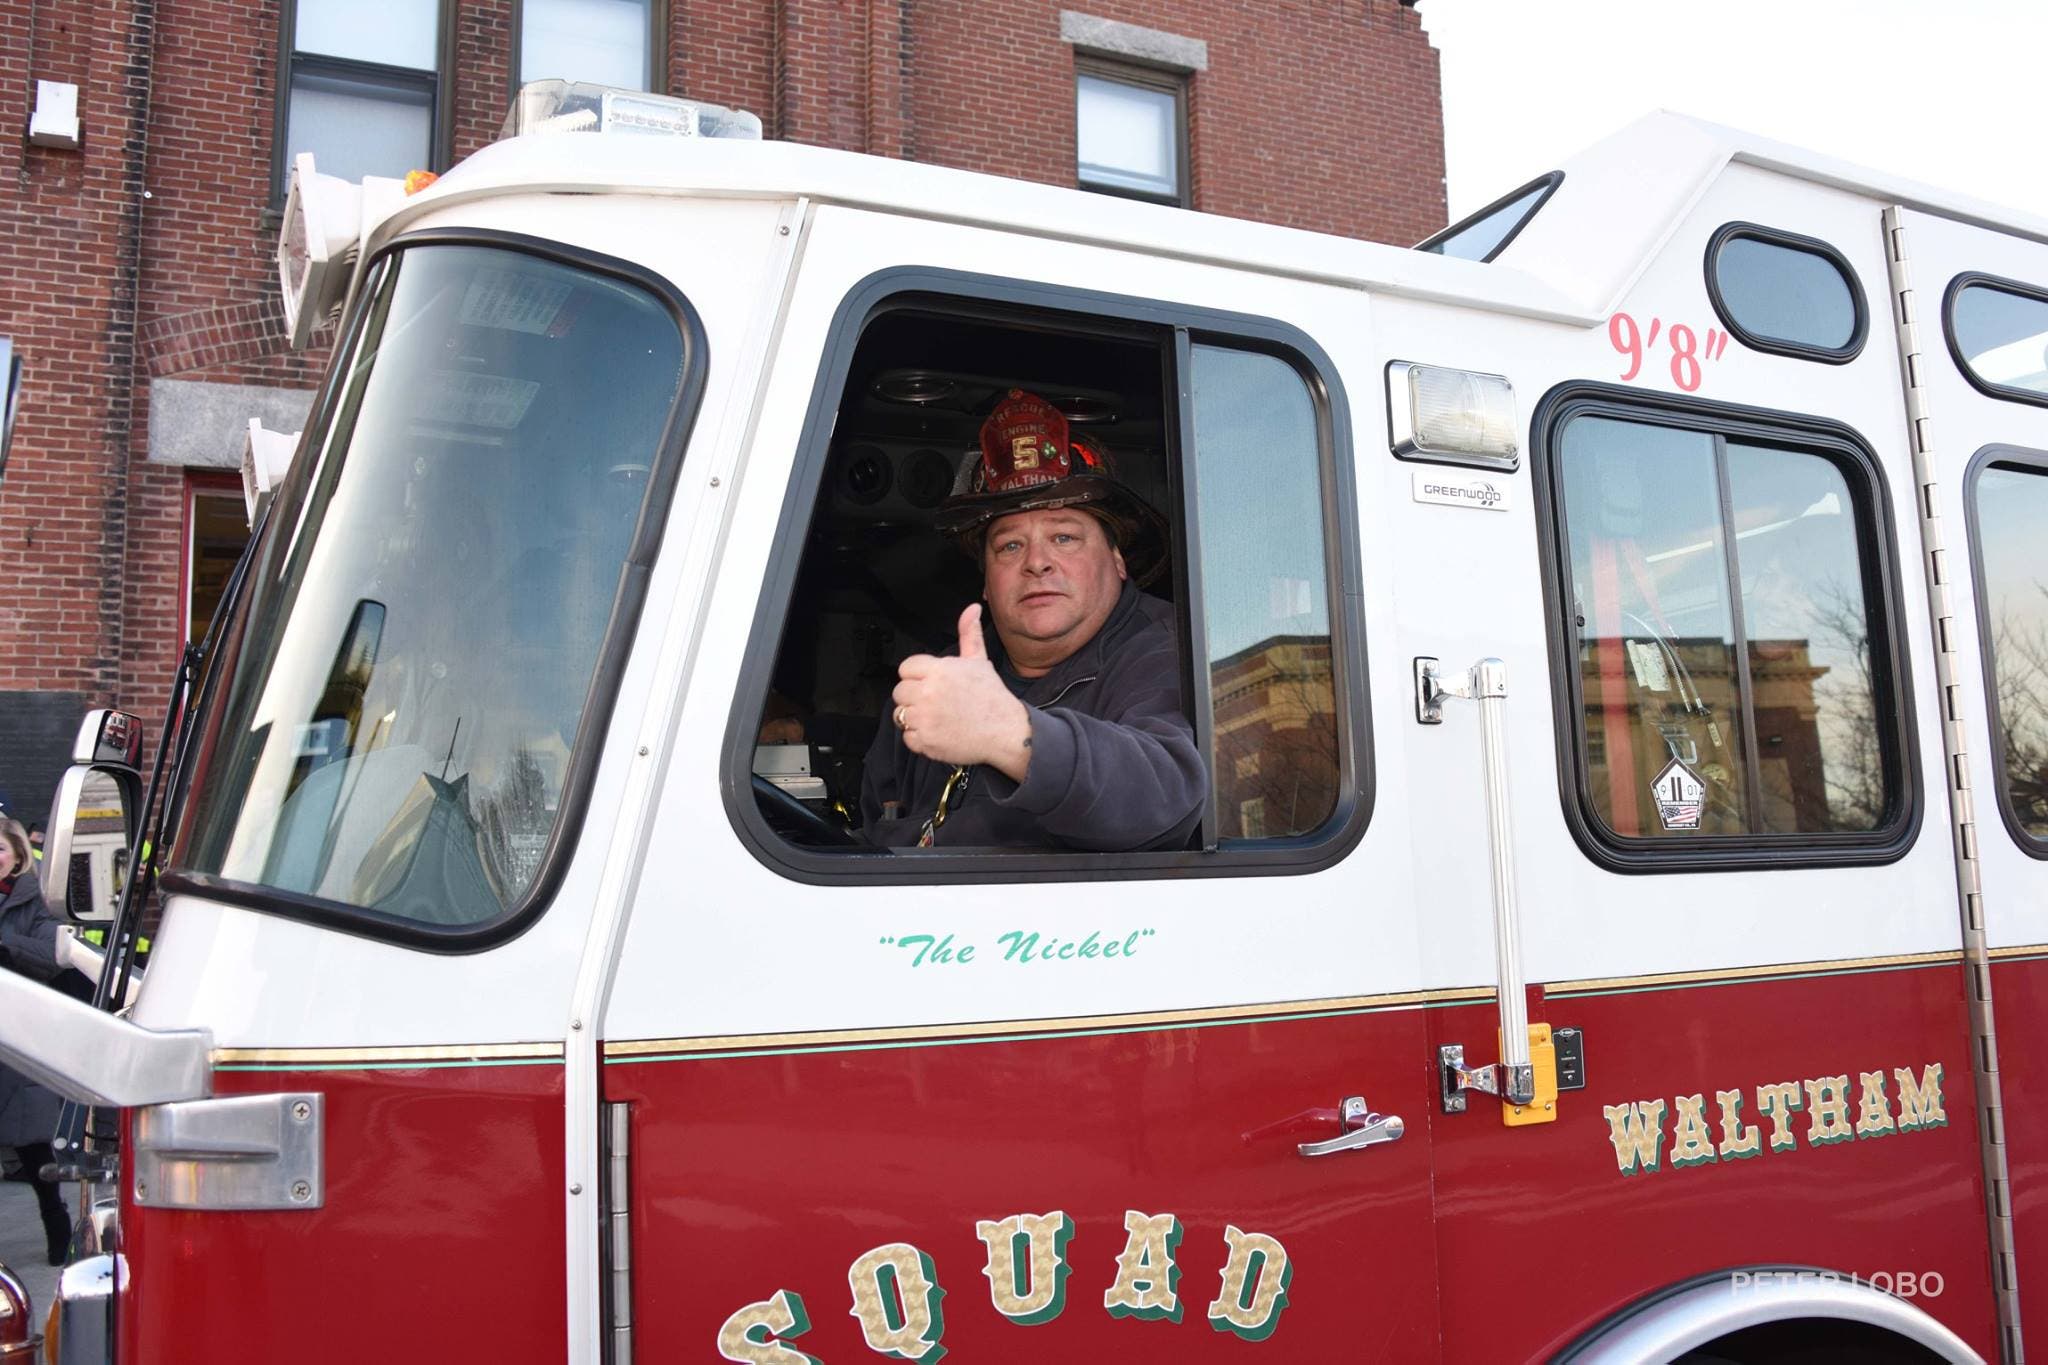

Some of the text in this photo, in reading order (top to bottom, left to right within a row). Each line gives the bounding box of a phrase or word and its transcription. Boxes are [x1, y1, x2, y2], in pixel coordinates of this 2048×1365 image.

[1002, 423, 1047, 440] ENGINE
[1012, 436, 1040, 471] 5
[1424, 484, 1501, 501] GREENWOOD
[1603, 1062, 1948, 1177] WALTHAM
[717, 1210, 1293, 1365] SQUAD
